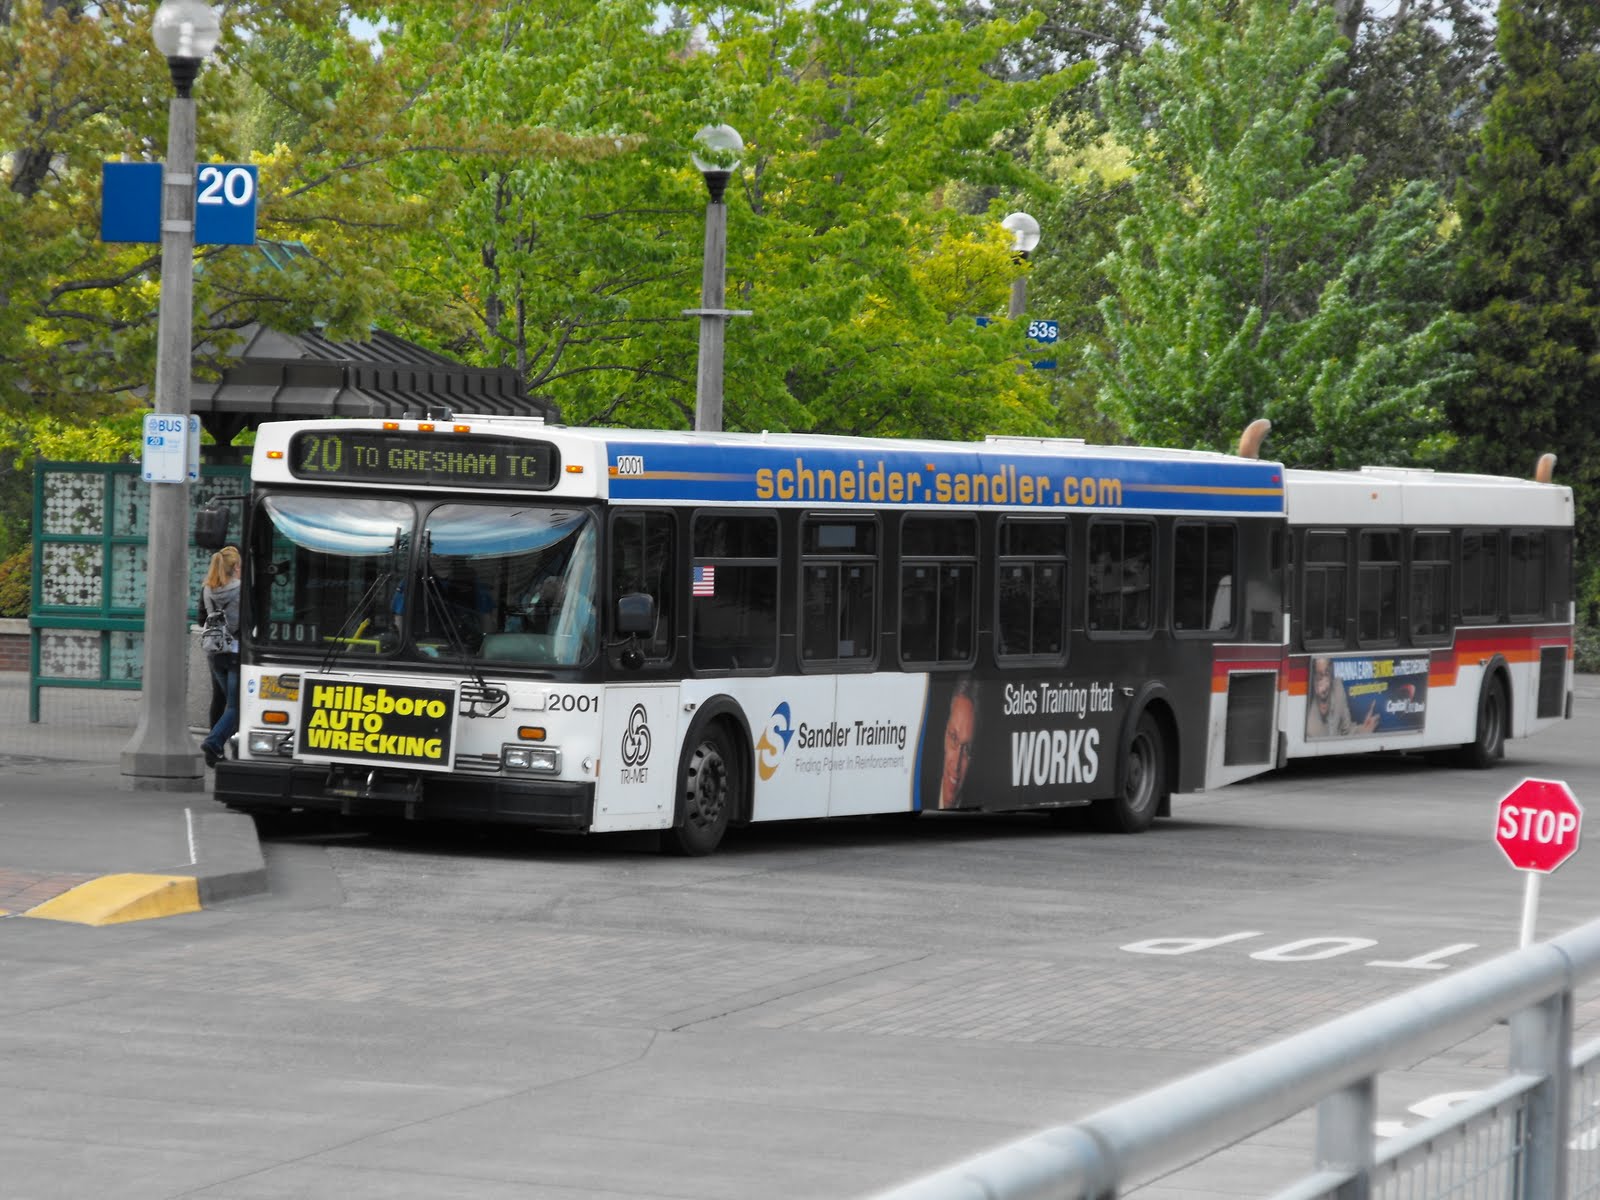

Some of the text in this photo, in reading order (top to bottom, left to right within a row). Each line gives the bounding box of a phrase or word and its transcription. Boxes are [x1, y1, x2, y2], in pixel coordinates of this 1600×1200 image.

[197, 167, 254, 206] 20
[1028, 321, 1057, 338] 53s
[159, 420, 181, 432] BUS
[302, 436, 536, 477] 20 TO GRESHAM TC
[618, 456, 642, 474] 2001
[755, 458, 1123, 507] schneider.sandler.com
[270, 623, 317, 642] 2001
[312, 685, 447, 719] Hillsboro
[548, 693, 599, 713] 2001
[1003, 681, 1114, 720] Sales Training that
[308, 709, 384, 733] AUTO
[798, 719, 907, 751] Sandler Training
[307, 728, 442, 759] WRECKING
[1011, 727, 1100, 787] WORKS
[620, 767, 649, 785] TRI-MET
[795, 758, 822, 775] Finding
[823, 757, 846, 773] Power
[855, 755, 905, 770] Reinforcement
[1499, 805, 1578, 845] STOP
